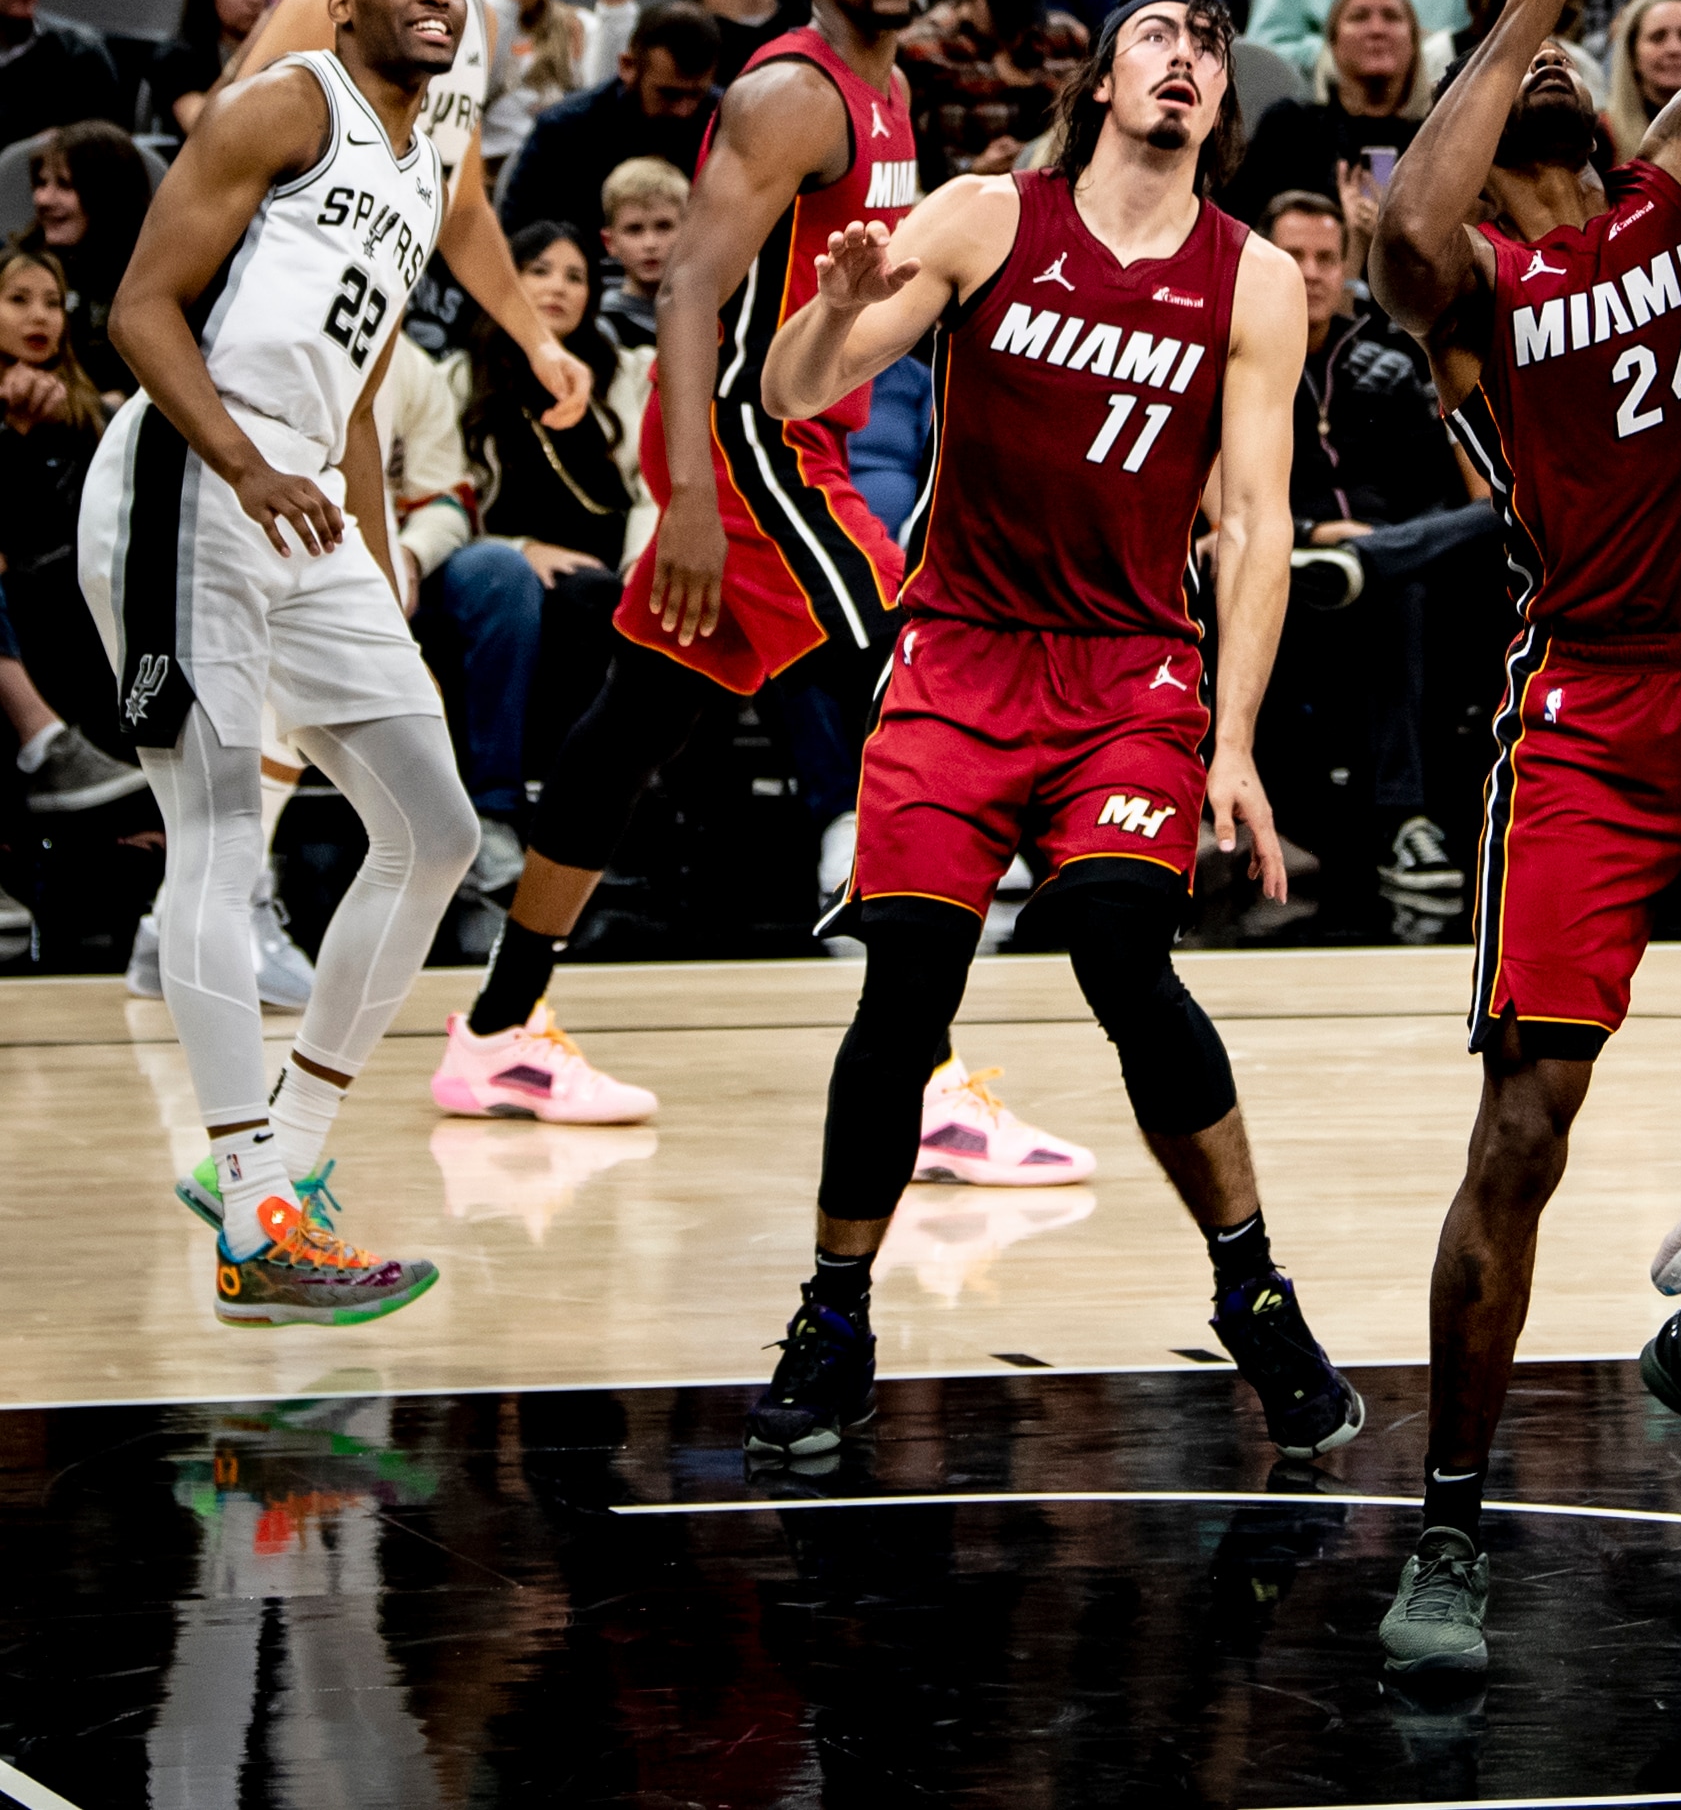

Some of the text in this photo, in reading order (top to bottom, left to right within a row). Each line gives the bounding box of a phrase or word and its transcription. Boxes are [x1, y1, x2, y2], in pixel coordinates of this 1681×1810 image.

[317, 186, 425, 291] SPURS
[320, 262, 389, 374] 22
[990, 302, 1205, 394] MIAMI
[1086, 393, 1173, 473] 11
